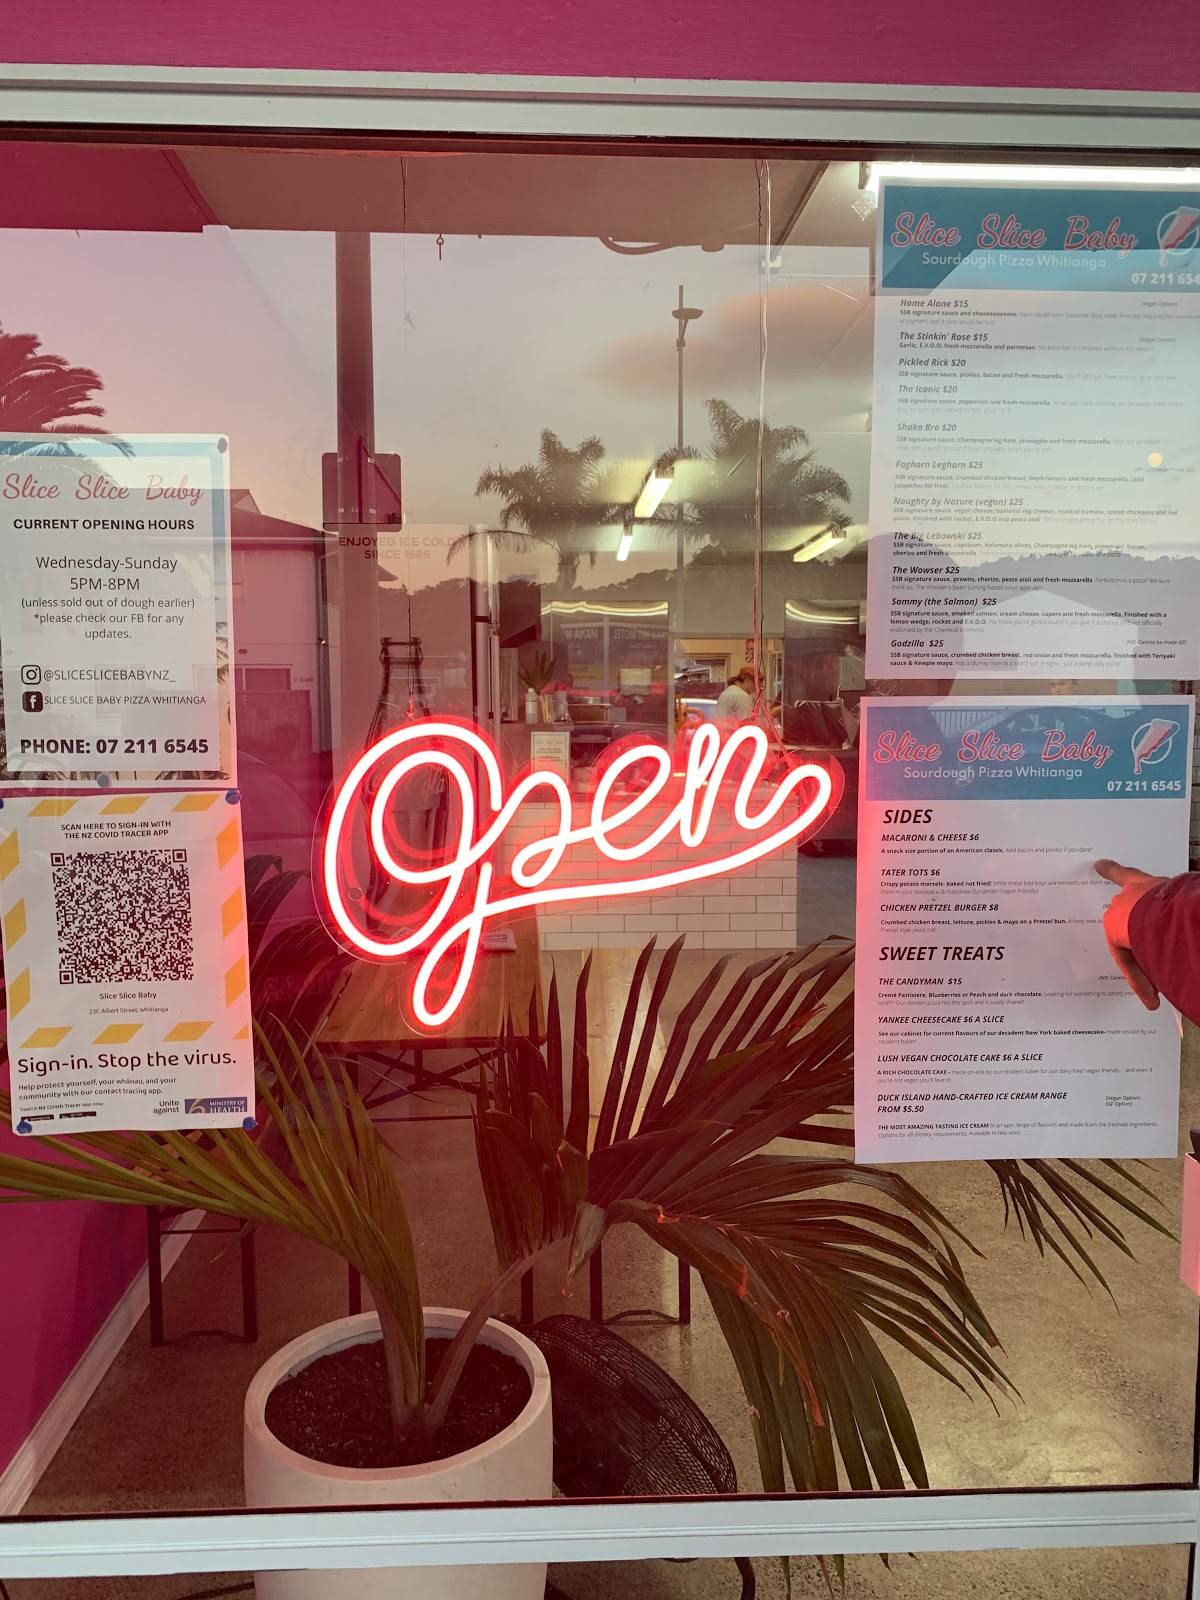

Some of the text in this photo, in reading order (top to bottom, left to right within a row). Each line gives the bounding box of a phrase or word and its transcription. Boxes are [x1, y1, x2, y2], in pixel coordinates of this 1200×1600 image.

[891, 211, 1136, 256] Slice Slice Baby
[1131, 272, 1147, 284] 07
[1150, 272, 1173, 284] 211
[900, 298, 968, 308] Home Alone $15
[900, 331, 914, 339] The
[950, 332, 971, 341] Rose
[972, 333, 988, 341] $15
[898, 357, 966, 366] Pickled Rick $20
[895, 460, 983, 470] Foghorn Leghorn $25
[2, 473, 204, 506] Slice Slice Baby
[13, 518, 194, 529] CURRENT OPENING HOURS
[967, 532, 982, 540] $25
[339, 537, 395, 547] ENJOYED
[400, 537, 418, 547] ICE
[364, 550, 431, 559] SINCE 1886
[35, 555, 177, 572] Wednesday-Sunday
[945, 566, 959, 574] $25
[70, 577, 139, 590] 5PM-8PM
[21, 597, 194, 609] (unless sold out of dough earlier)
[891, 597, 996, 607] Sammy (the Salmon) $25
[75, 612, 105, 622] check
[131, 613, 144, 622] FB
[147, 613, 162, 623] for
[165, 615, 184, 625] any
[84, 628, 131, 640] updates.
[890, 639, 944, 647] Godzilla $25
[44, 695, 206, 704] SLICE SLICE BABY PIZZA WHITIANGA
[20, 738, 208, 753] PHONE: 07 211 6545
[872, 728, 1110, 768] Slice Slice Baby
[903, 766, 1082, 781] Sourdough Pizza Whitianga
[1107, 780, 1181, 791] 07 211 6545
[883, 809, 932, 823] SIDES
[83, 822, 104, 830] HERE
[118, 821, 148, 829] SIGN-IN
[120, 829, 151, 837] TRACER
[881, 833, 926, 841] MACARONI
[937, 833, 967, 841] CHEESE
[881, 868, 940, 876] TATER TOTS $6
[988, 903, 998, 911] $8
[878, 946, 1005, 960] SWEET TREATS
[138, 991, 156, 999] Baby
[877, 1054, 898, 1062] LUSH
[18, 1050, 236, 1077] Sign-in. Stop the virus.
[18, 1083, 35, 1091] Help
[36, 1081, 64, 1090] protect
[19, 1091, 61, 1101] community
[62, 1090, 78, 1098] with
[122, 1088, 147, 1097] tracing
[901, 1093, 930, 1101] ISLAND
[995, 1092, 1008, 1100] ICE
[159, 1099, 179, 1108] Unite
[153, 1106, 179, 1115] against
[208, 1106, 246, 1114] HEALTH
